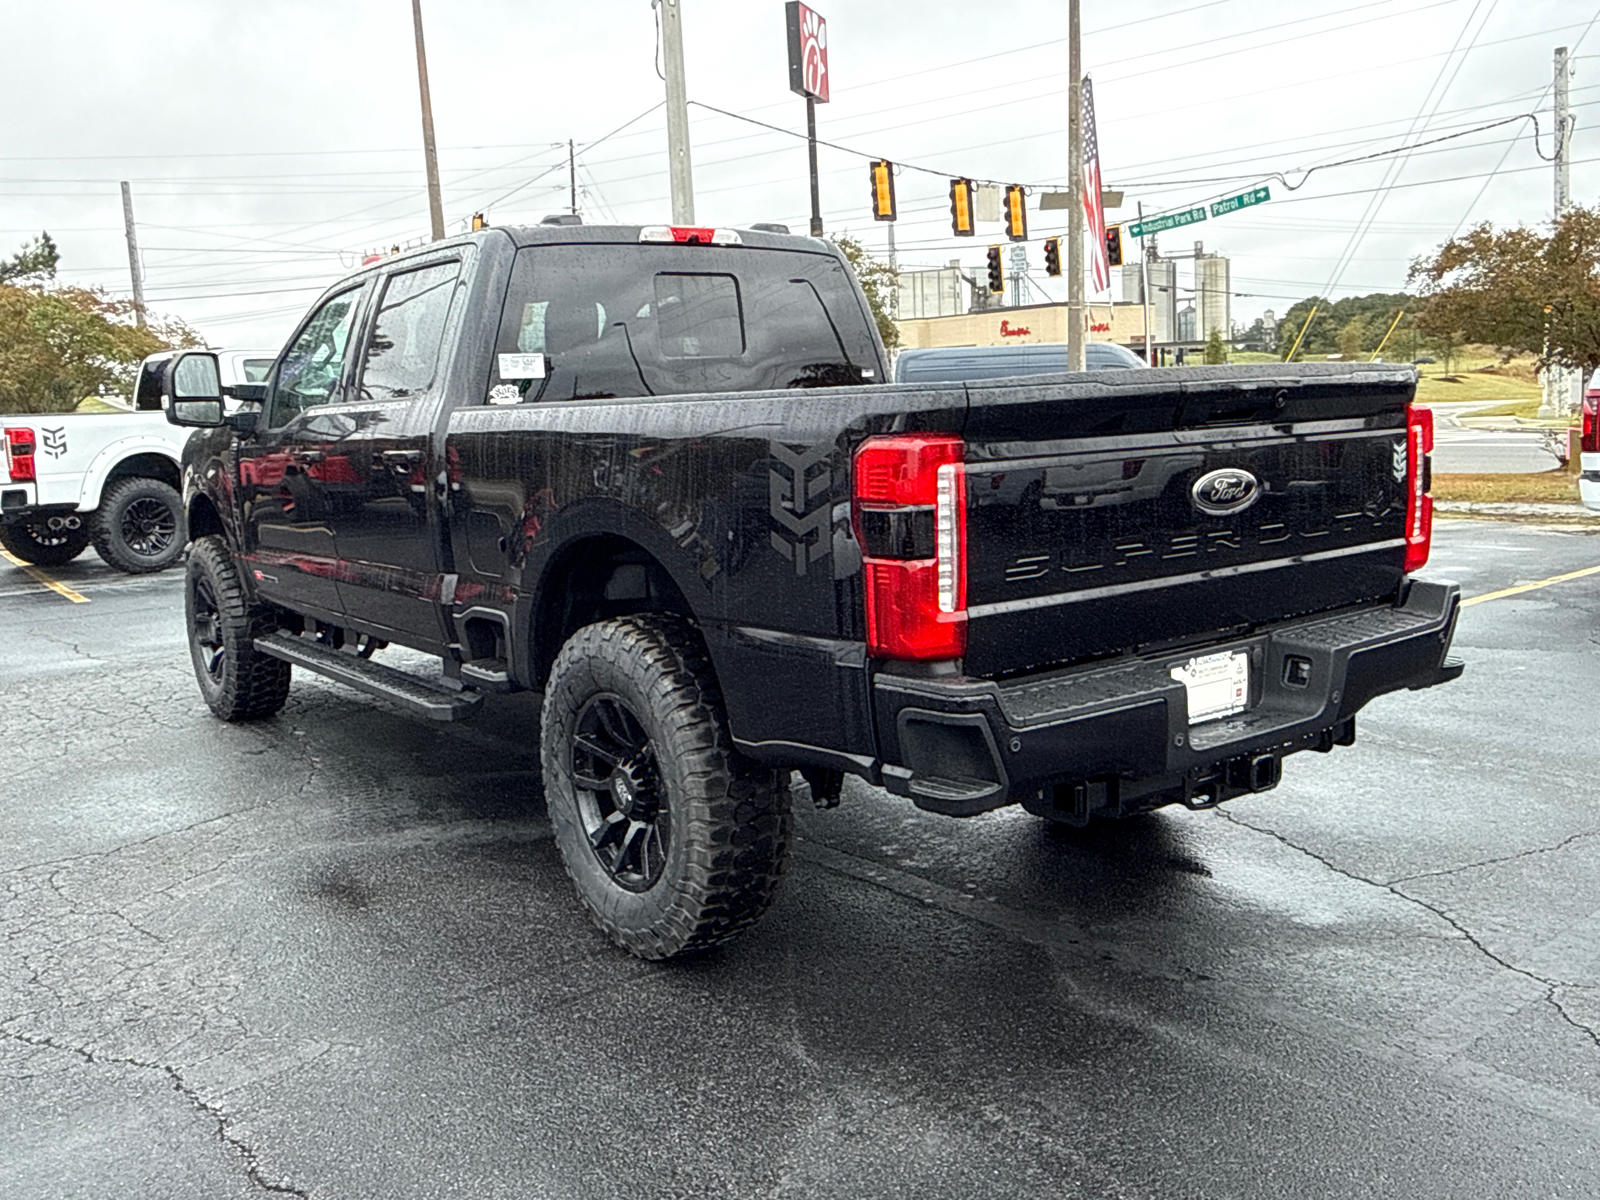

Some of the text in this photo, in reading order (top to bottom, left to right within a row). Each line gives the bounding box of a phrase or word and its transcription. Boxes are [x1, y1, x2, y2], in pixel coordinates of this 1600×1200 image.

[1212, 193, 1256, 215] Patrol Rd
[1141, 210, 1204, 233] Industrial Park Rd
[1210, 477, 1246, 502] Ford
[1004, 503, 1393, 582] SUPER DUTY
